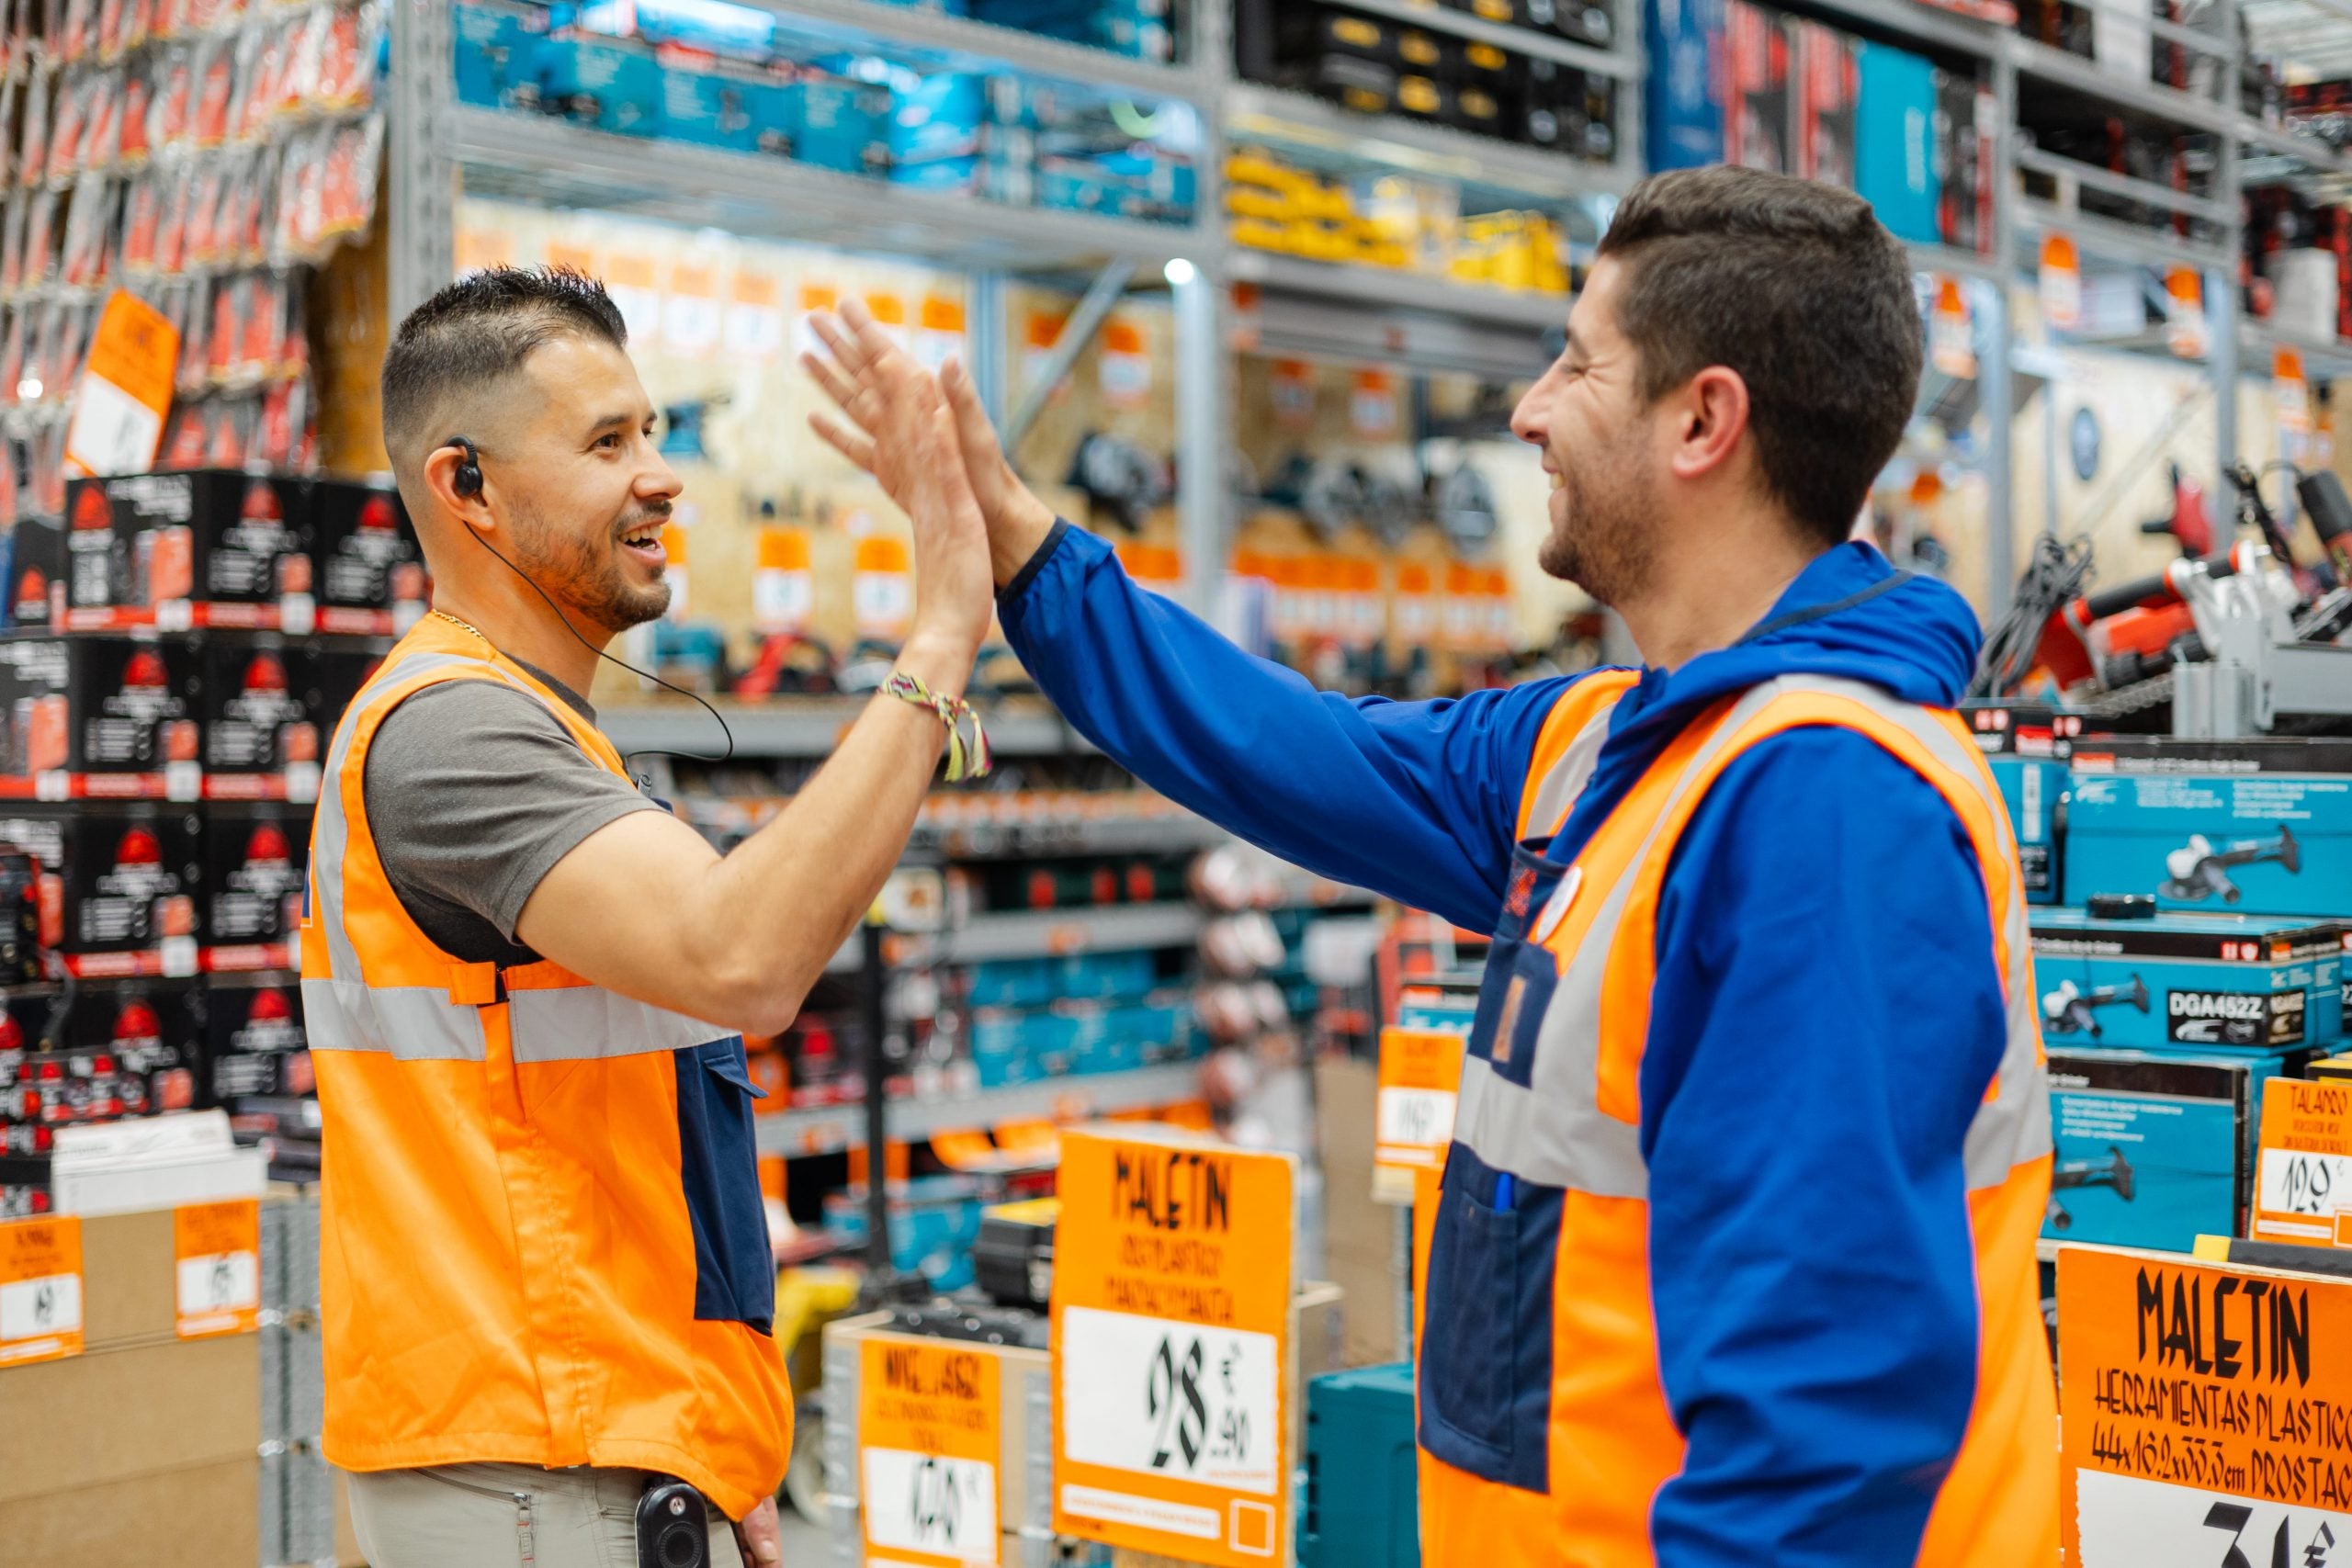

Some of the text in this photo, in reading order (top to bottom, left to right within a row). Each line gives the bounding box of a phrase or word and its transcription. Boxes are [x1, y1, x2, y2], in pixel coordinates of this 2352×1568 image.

[2169, 992, 2264, 1020] DGA452Z
[1112, 1151, 1230, 1233] MALETIN
[2282, 1156, 2331, 1213] 129
[2137, 1266, 2310, 1389] MALETIN
[1147, 1337, 1206, 1468] 28
[2095, 1367, 2250, 1435] HERRAMIENTAS
